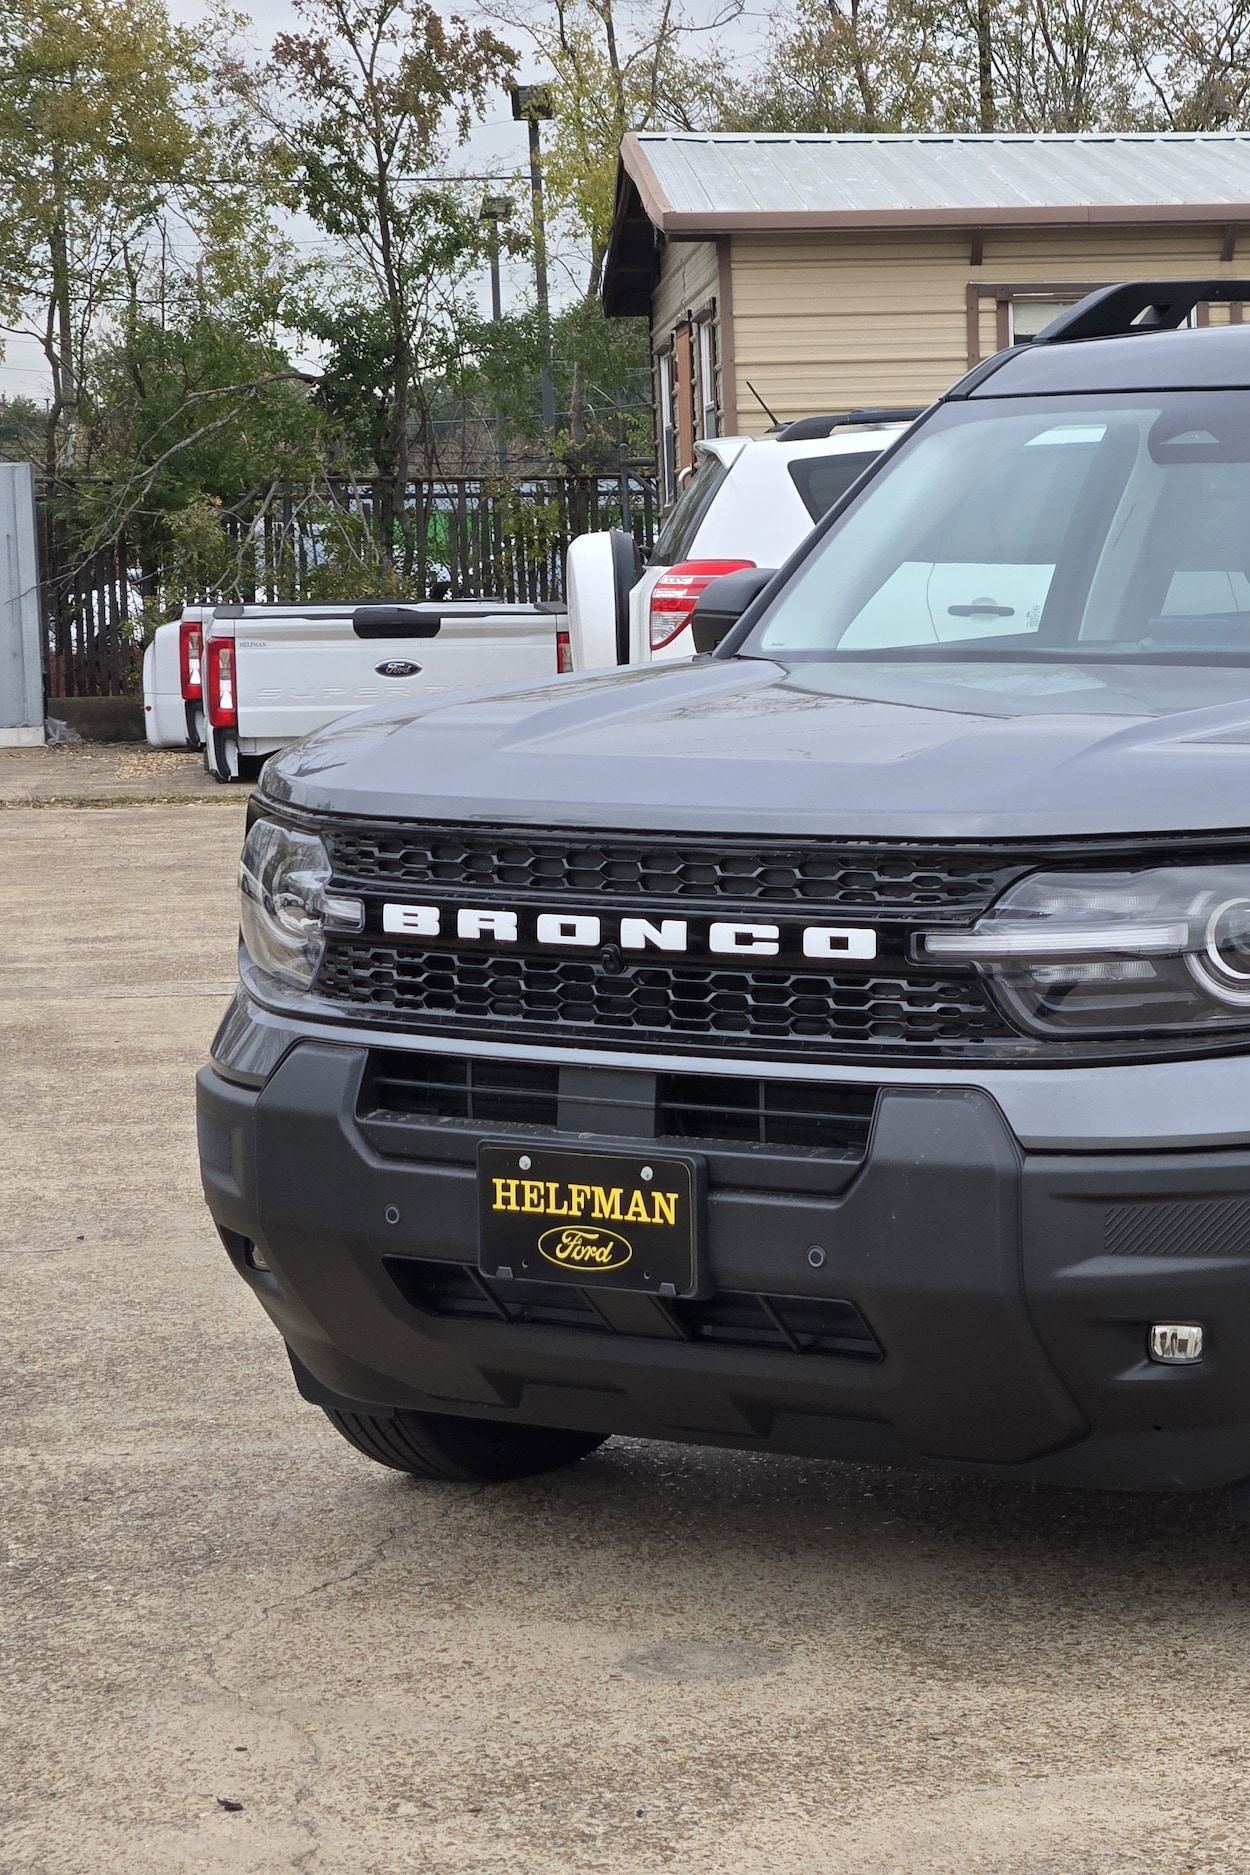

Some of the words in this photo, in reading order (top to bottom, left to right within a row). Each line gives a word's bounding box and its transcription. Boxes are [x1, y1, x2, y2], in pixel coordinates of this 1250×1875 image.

[386, 662, 412, 674] Ford
[256, 686, 411, 699] SUPER
[383, 903, 877, 960] BRONCO
[492, 1178, 679, 1225] HELFMAN
[555, 1230, 615, 1263] Ford
